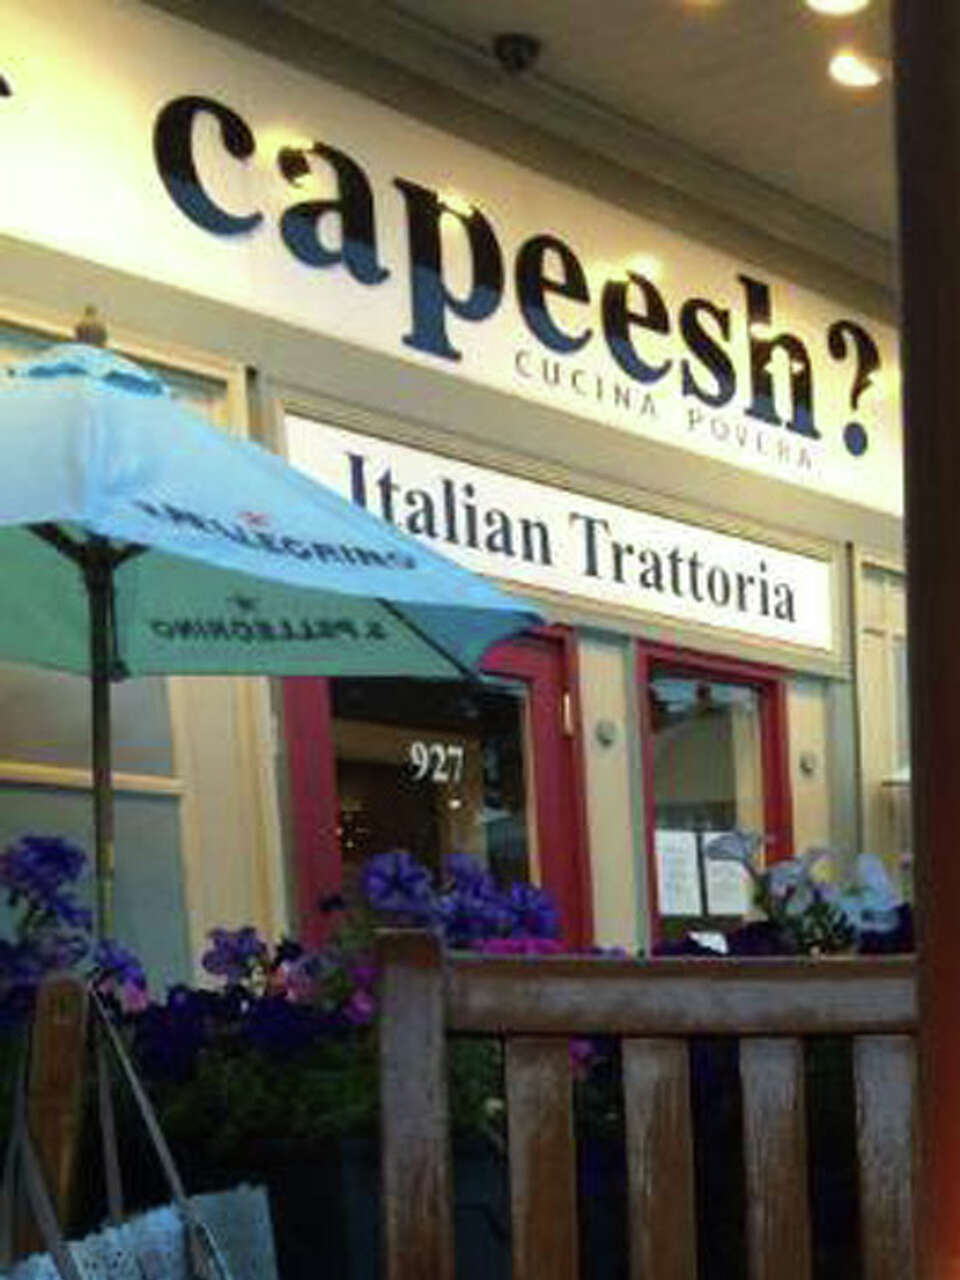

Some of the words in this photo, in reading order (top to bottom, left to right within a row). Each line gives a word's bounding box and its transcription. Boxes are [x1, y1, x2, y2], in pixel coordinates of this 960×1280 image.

[152, 95, 882, 458] capeesh?
[514, 350, 657, 416] CUCINA
[346, 453, 553, 567] Italian
[569, 512, 797, 623] Trattoria
[411, 741, 464, 783] 927
